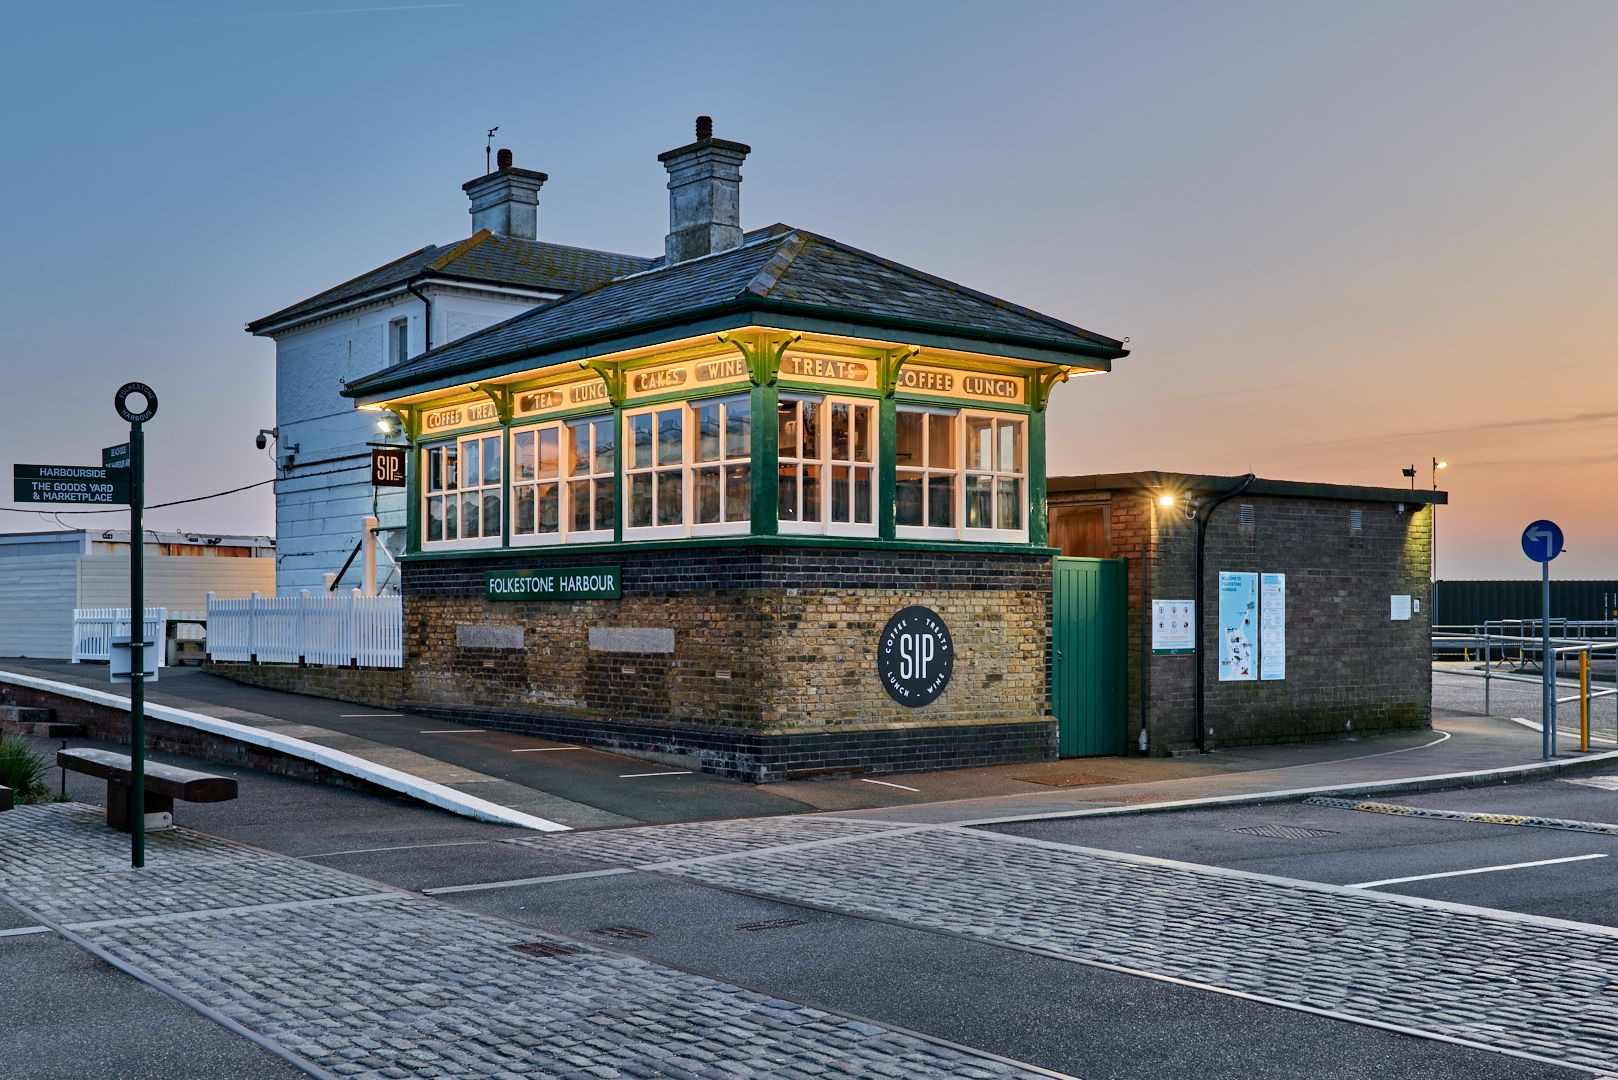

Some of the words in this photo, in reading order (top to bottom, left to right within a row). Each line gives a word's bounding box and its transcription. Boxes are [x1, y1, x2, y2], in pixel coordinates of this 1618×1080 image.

[640, 370, 680, 390] CAKES
[708, 360, 743, 379] WINE
[791, 357, 856, 379] TREATS
[966, 377, 1016, 396] LUNCH
[534, 393, 553, 409] TEA
[121, 409, 152, 422] HARBOUR
[429, 409, 461, 428] COFFEE
[39, 467, 106, 478] HARBOURSIDE
[377, 455, 399, 481] SIP
[32, 481, 51, 491] THE
[53, 482, 87, 492] GOODS
[89, 483, 114, 493] YARD
[32, 491, 41, 501] &
[43, 492, 113, 502] MARKETPLACE
[489, 576, 554, 593] FOLKESTONE
[559, 574, 615, 592] HARBOUR
[885, 619, 907, 654] COFFEE
[926, 618, 948, 651] TREATS
[900, 633, 935, 680] SIP
[887, 671, 910, 698] LUNCH
[926, 672, 945, 694] WINE
